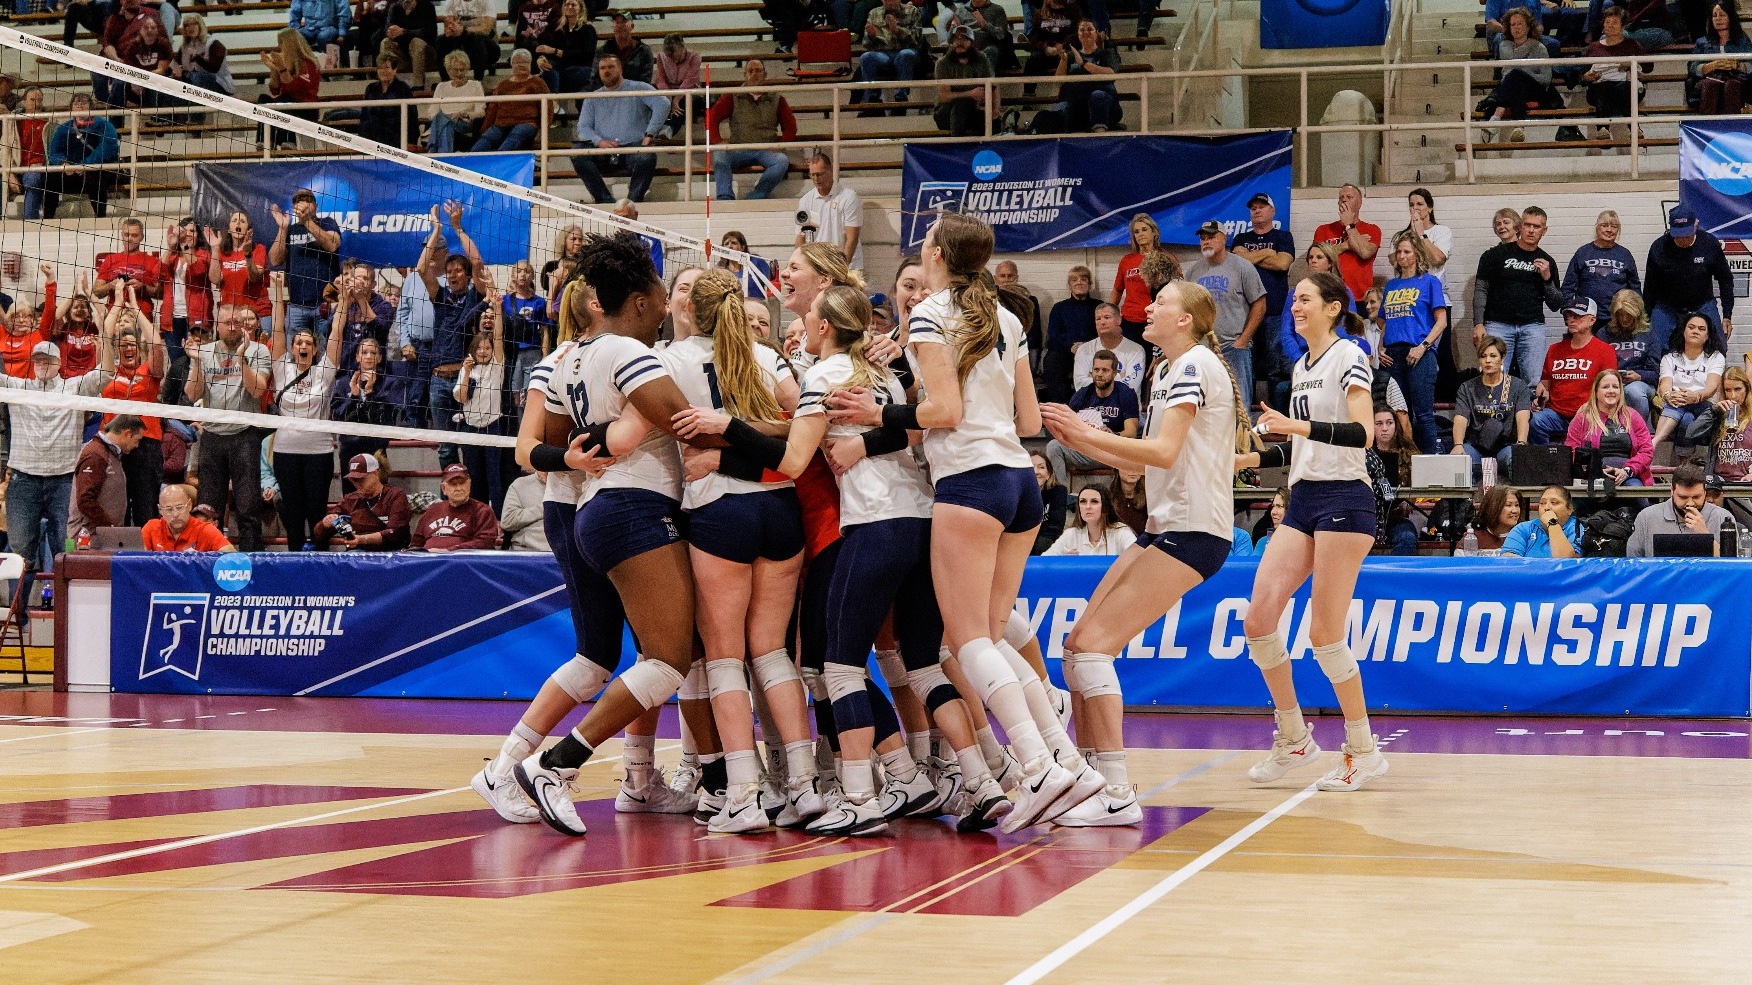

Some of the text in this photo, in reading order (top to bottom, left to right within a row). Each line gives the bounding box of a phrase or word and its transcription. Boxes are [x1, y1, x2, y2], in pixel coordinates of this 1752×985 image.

[974, 164, 1002, 174] NCAA
[1708, 162, 1752, 179] NCA
[971, 178, 1083, 191] 2023 DIVISION II WOMEN'S
[967, 187, 1074, 211] VOLLEYBALL
[1585, 258, 1625, 269] DBU
[1552, 358, 1593, 372] DBU
[1151, 389, 1168, 401] VER
[566, 380, 596, 430] 12
[1292, 394, 1310, 422] 10
[1721, 433, 1744, 442] EXAS
[429, 515, 467, 532] WTAMU
[217, 569, 251, 581] NCAA
[214, 596, 356, 607] 2023 DIVISION II WOMEN'S
[210, 609, 345, 636] VOLLEYBALL
[207, 637, 326, 656] CHAMPIONSHIP
